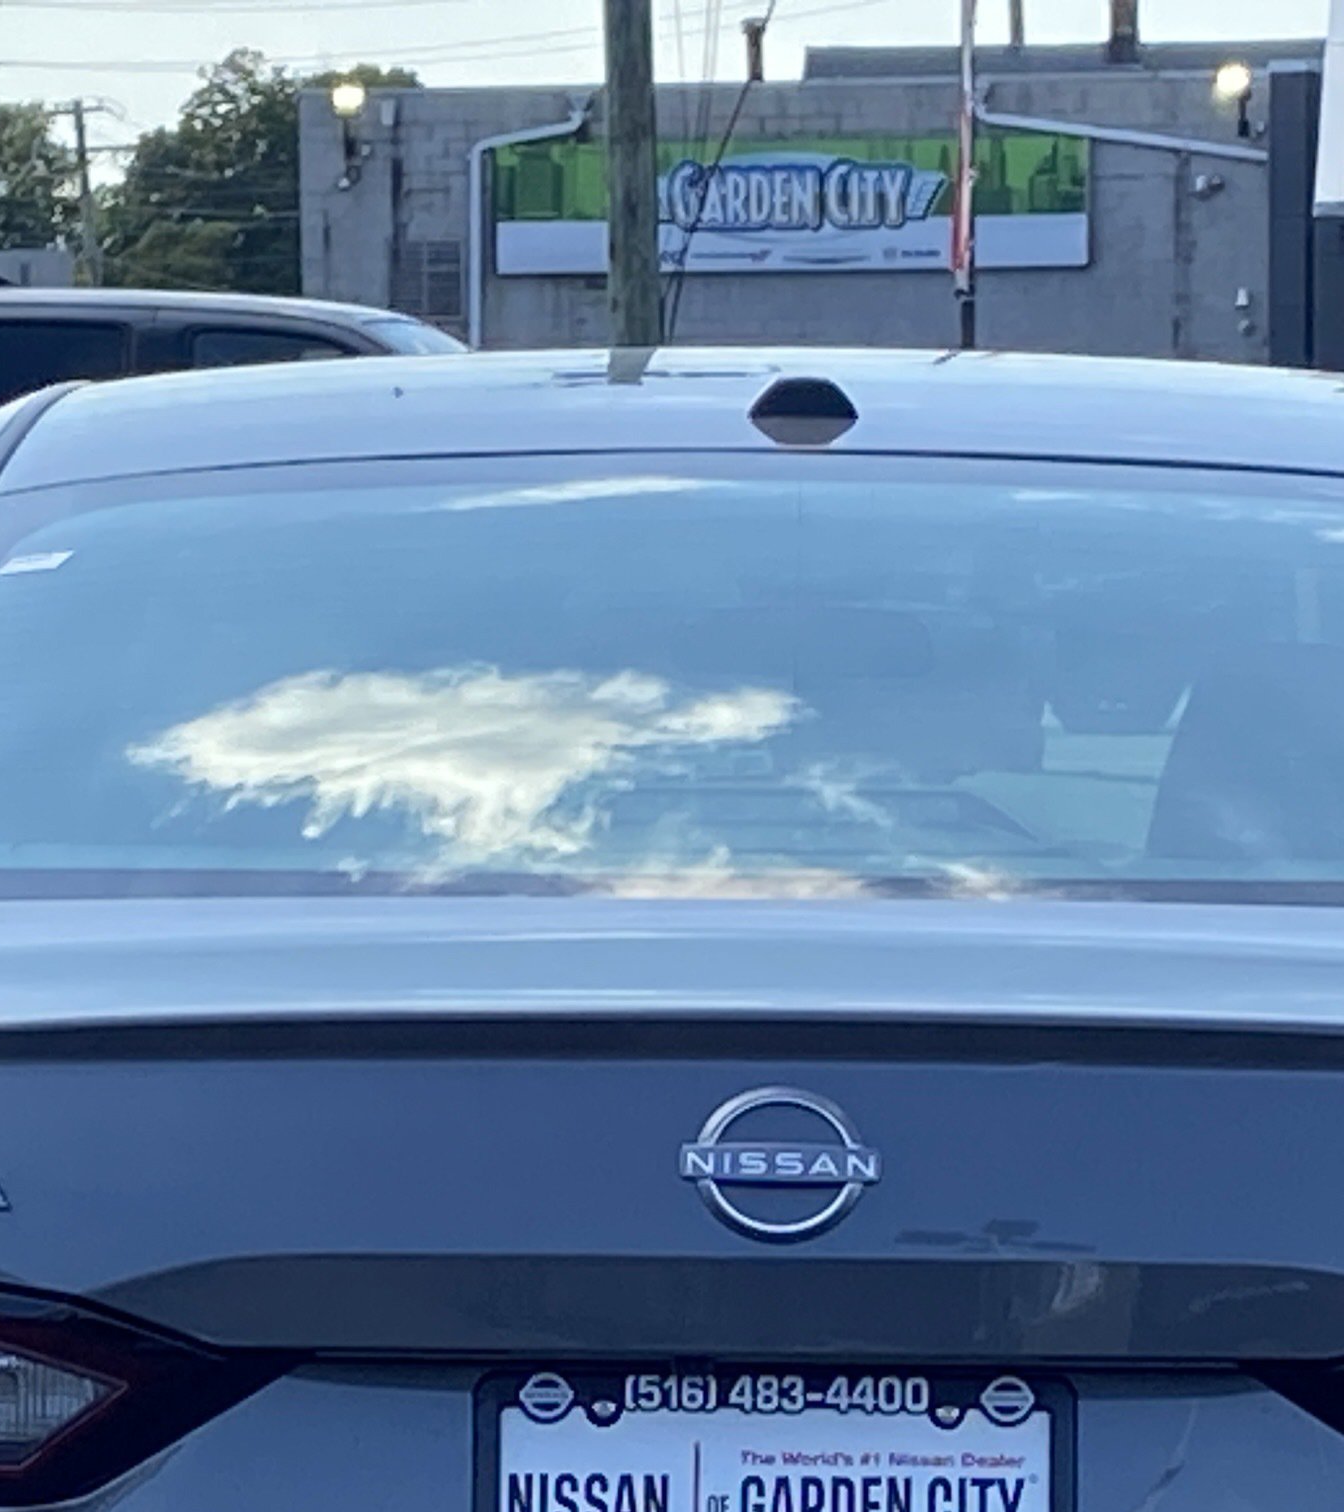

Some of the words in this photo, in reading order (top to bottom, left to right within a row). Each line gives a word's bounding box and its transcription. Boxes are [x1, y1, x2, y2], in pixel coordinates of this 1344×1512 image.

[669, 162, 820, 228] GARDEN
[827, 161, 907, 228] CITY
[685, 1151, 875, 1177] NISSAN
[623, 1374, 717, 1411] (516)
[728, 1374, 929, 1413] 483-4400
[740, 1450, 775, 1466] The
[782, 1450, 855, 1467] World's
[860, 1452, 881, 1467] #1
[888, 1452, 954, 1468] Nissan
[960, 1452, 1027, 1468] Dealer
